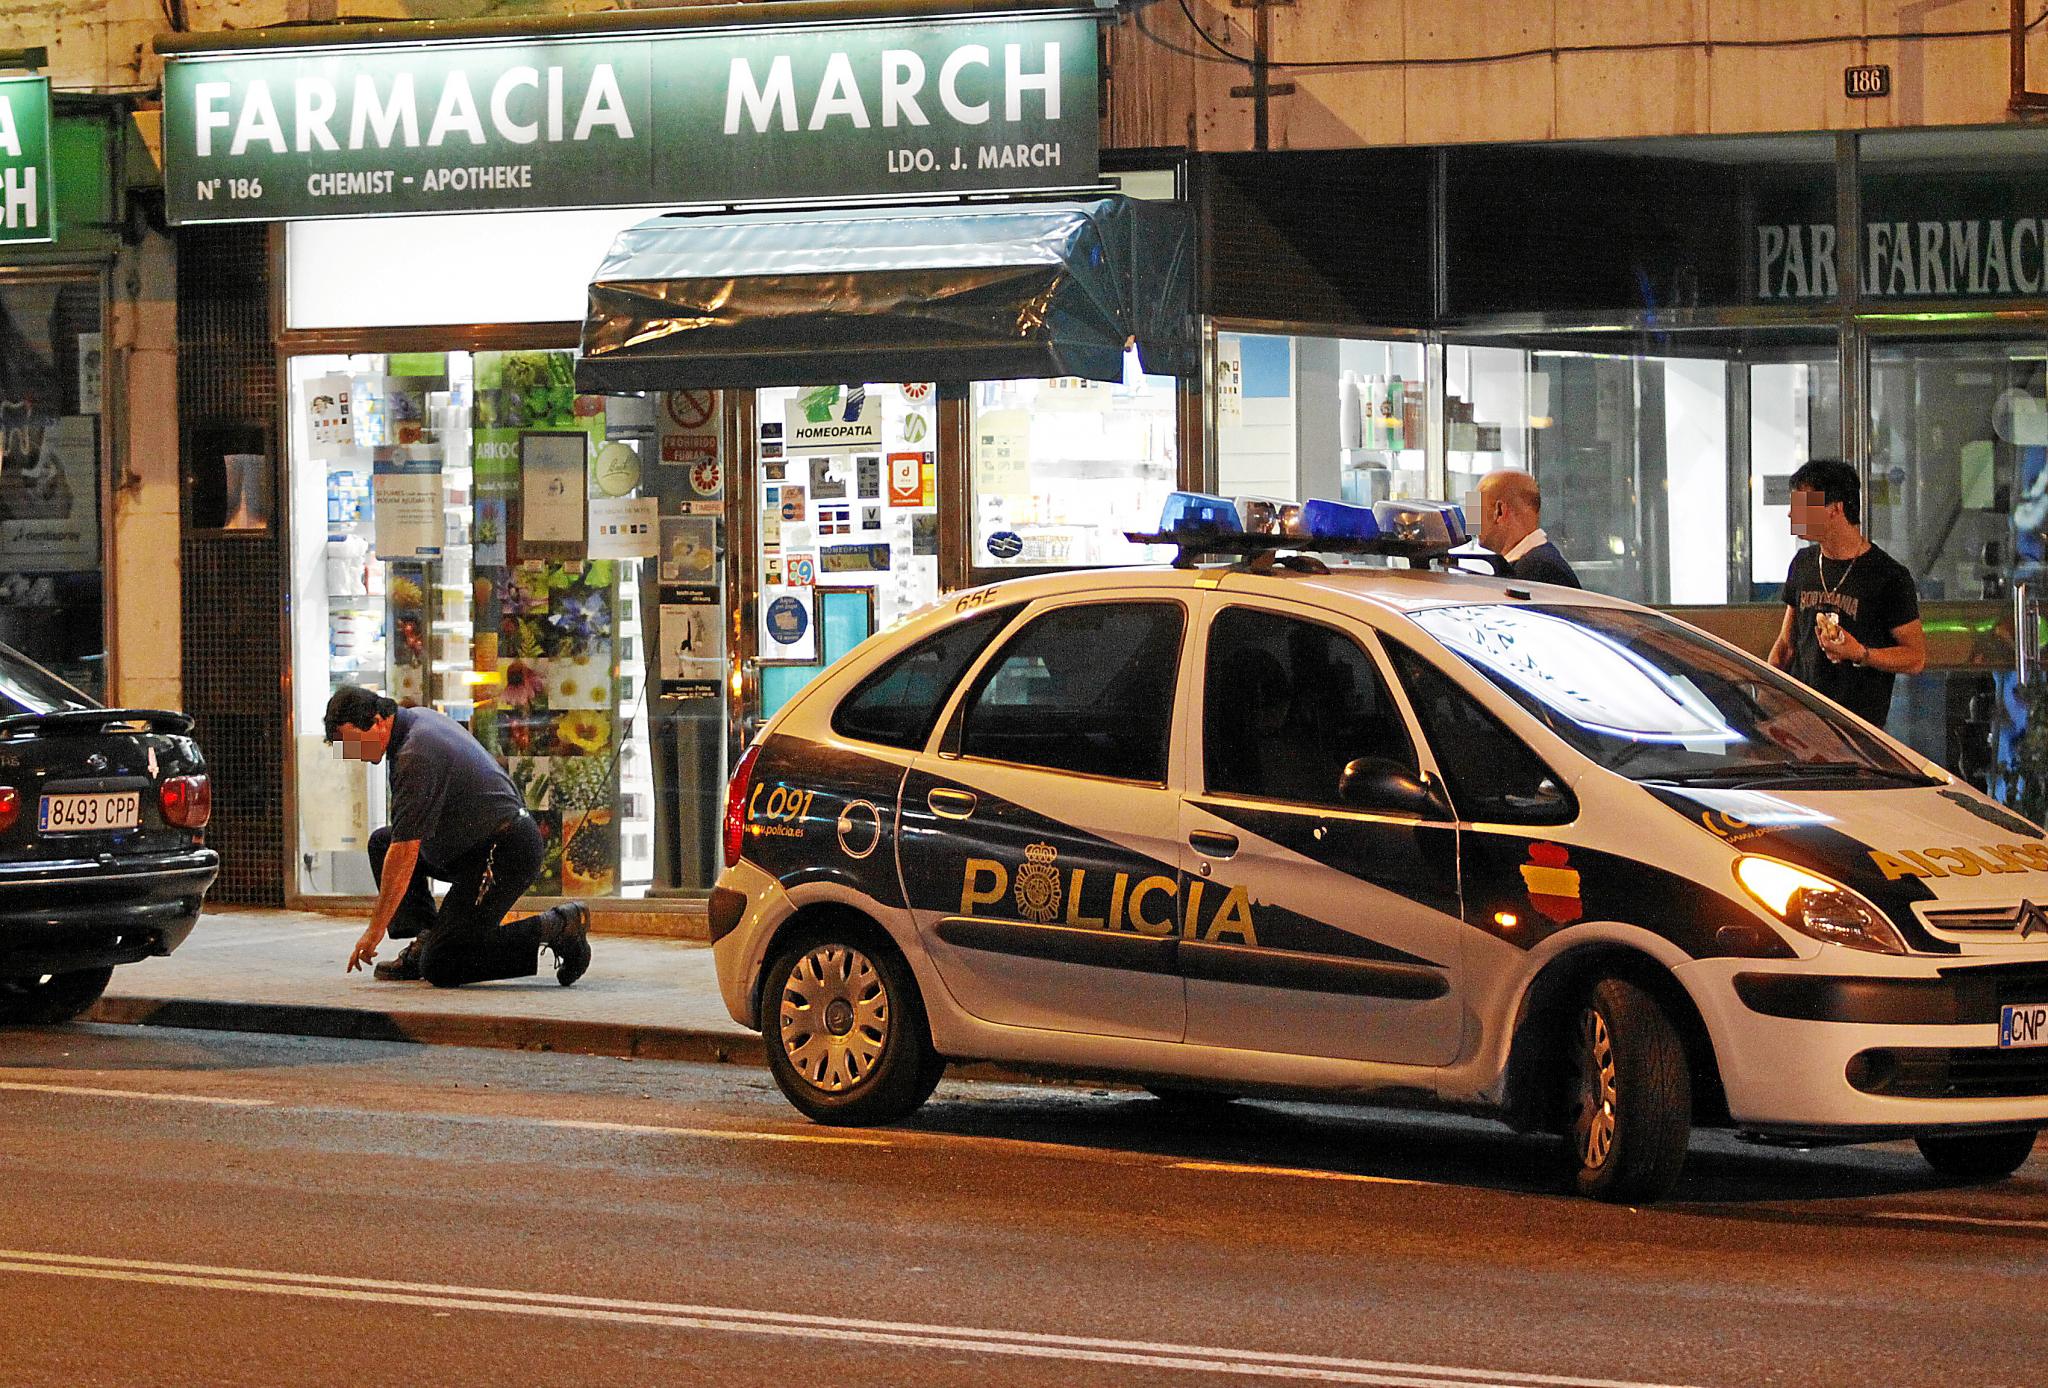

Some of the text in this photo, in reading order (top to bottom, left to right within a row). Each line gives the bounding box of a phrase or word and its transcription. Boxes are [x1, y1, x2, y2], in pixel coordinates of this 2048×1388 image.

[1851, 70, 1881, 92] 186
[195, 42, 1060, 157] FARMACIA MARCH
[888, 143, 1061, 174] LDO. J. MARCH
[228, 177, 263, 200] 186
[307, 171, 395, 197] CHEMIST
[422, 165, 532, 192] APOTHEKE
[796, 426, 872, 439] HOMEOPATIA
[52, 797, 135, 825] 8493 CPP
[767, 787, 814, 824] 091
[2011, 1009, 2047, 1041] CNP
